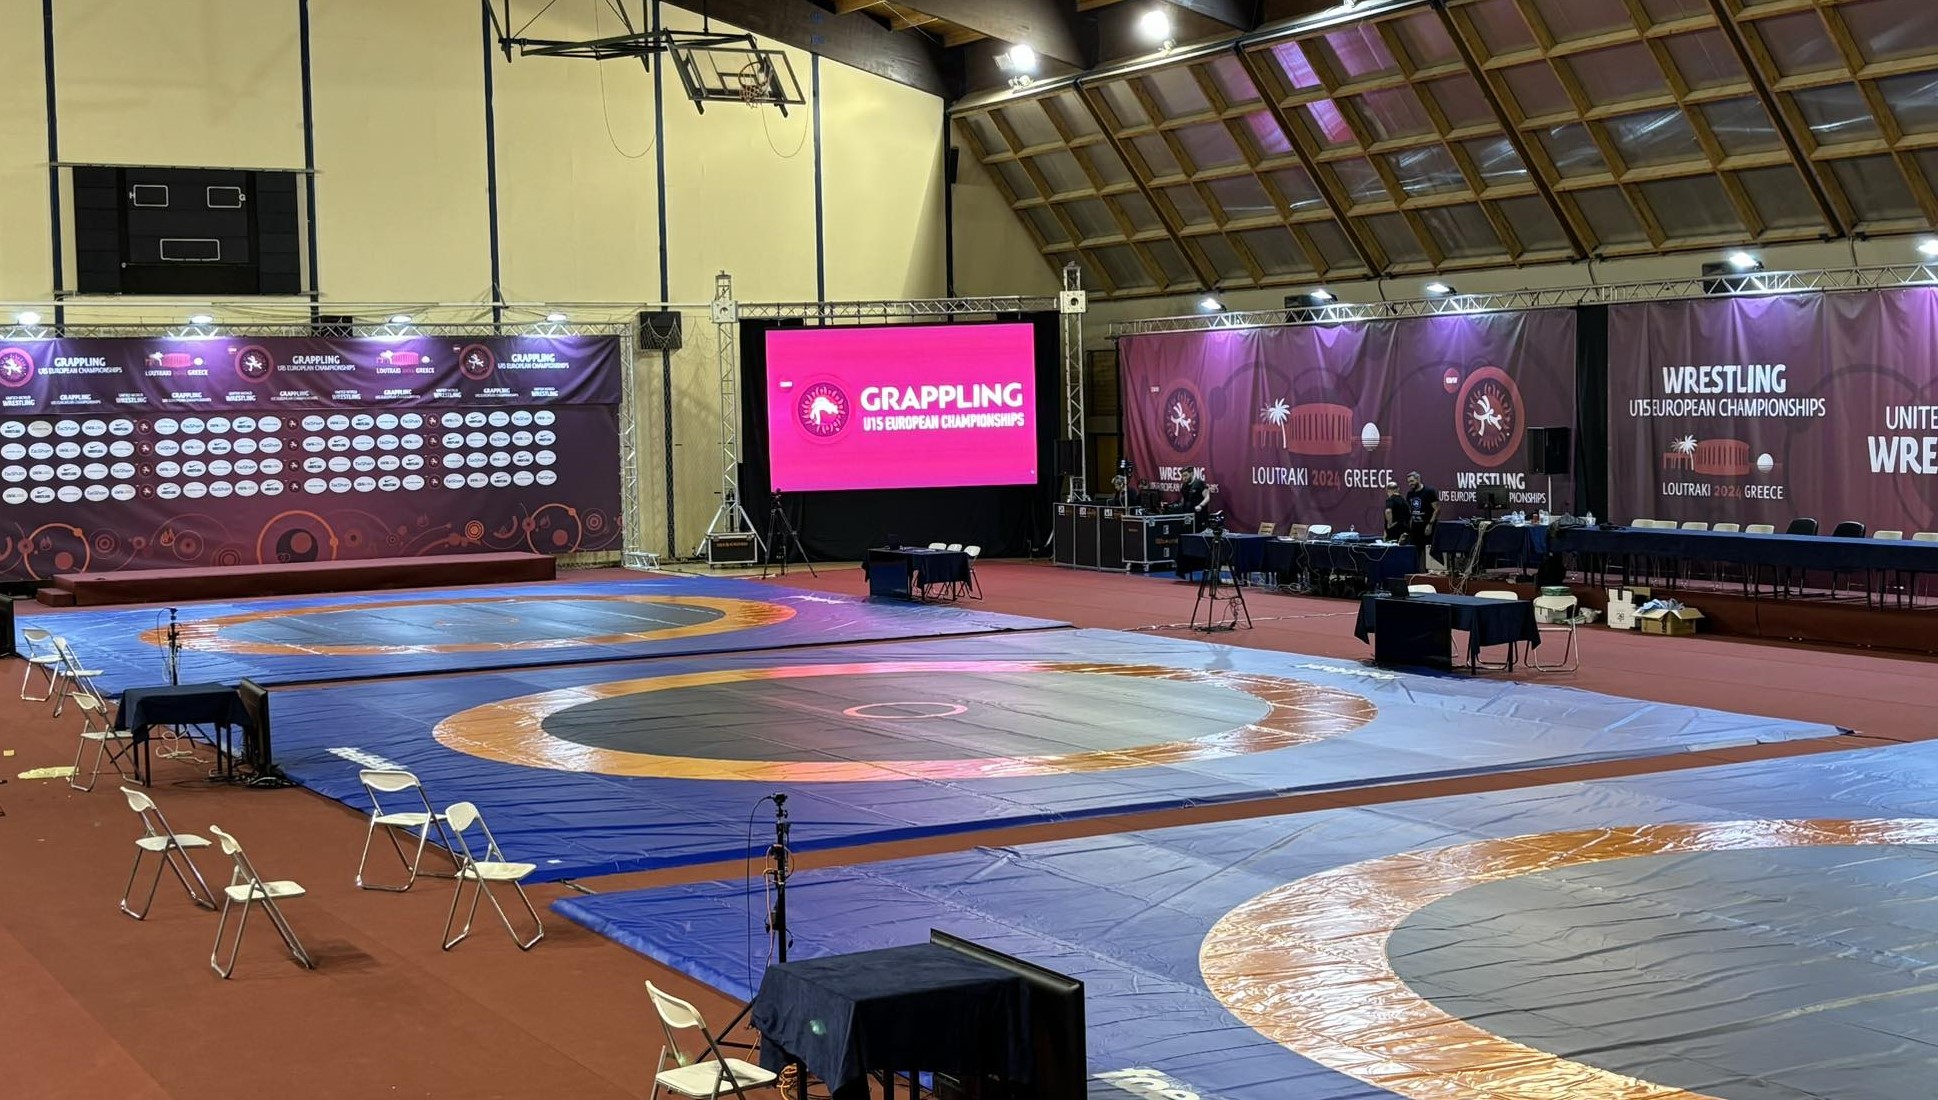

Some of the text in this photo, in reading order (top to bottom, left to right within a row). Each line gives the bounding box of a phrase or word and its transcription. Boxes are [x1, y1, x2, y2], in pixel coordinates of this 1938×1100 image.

[54, 357, 106, 368] GRAPPLING
[292, 355, 340, 364] GRAPPLING
[512, 354, 555, 362] GRAPPLING
[1662, 364, 1787, 394] WRESTLING
[860, 382, 1024, 412] GRAPPLING
[1629, 397, 1826, 417] U15 EUROPEAN CHAMPIONSHIPS
[864, 412, 1025, 431] U15 EUROPEAN CHAMPIONSHIPS
[1867, 436, 1938, 474] WRE
[1159, 466, 1206, 480] WRESNG
[1252, 466, 1393, 490] LOUTRAKI 2024 GREECE
[1450, 491, 1477, 502] EUROPE
[1509, 492, 1546, 504] PIONSHIPS
[1662, 482, 1784, 501] LOUTRAKI 2024 GREECE
